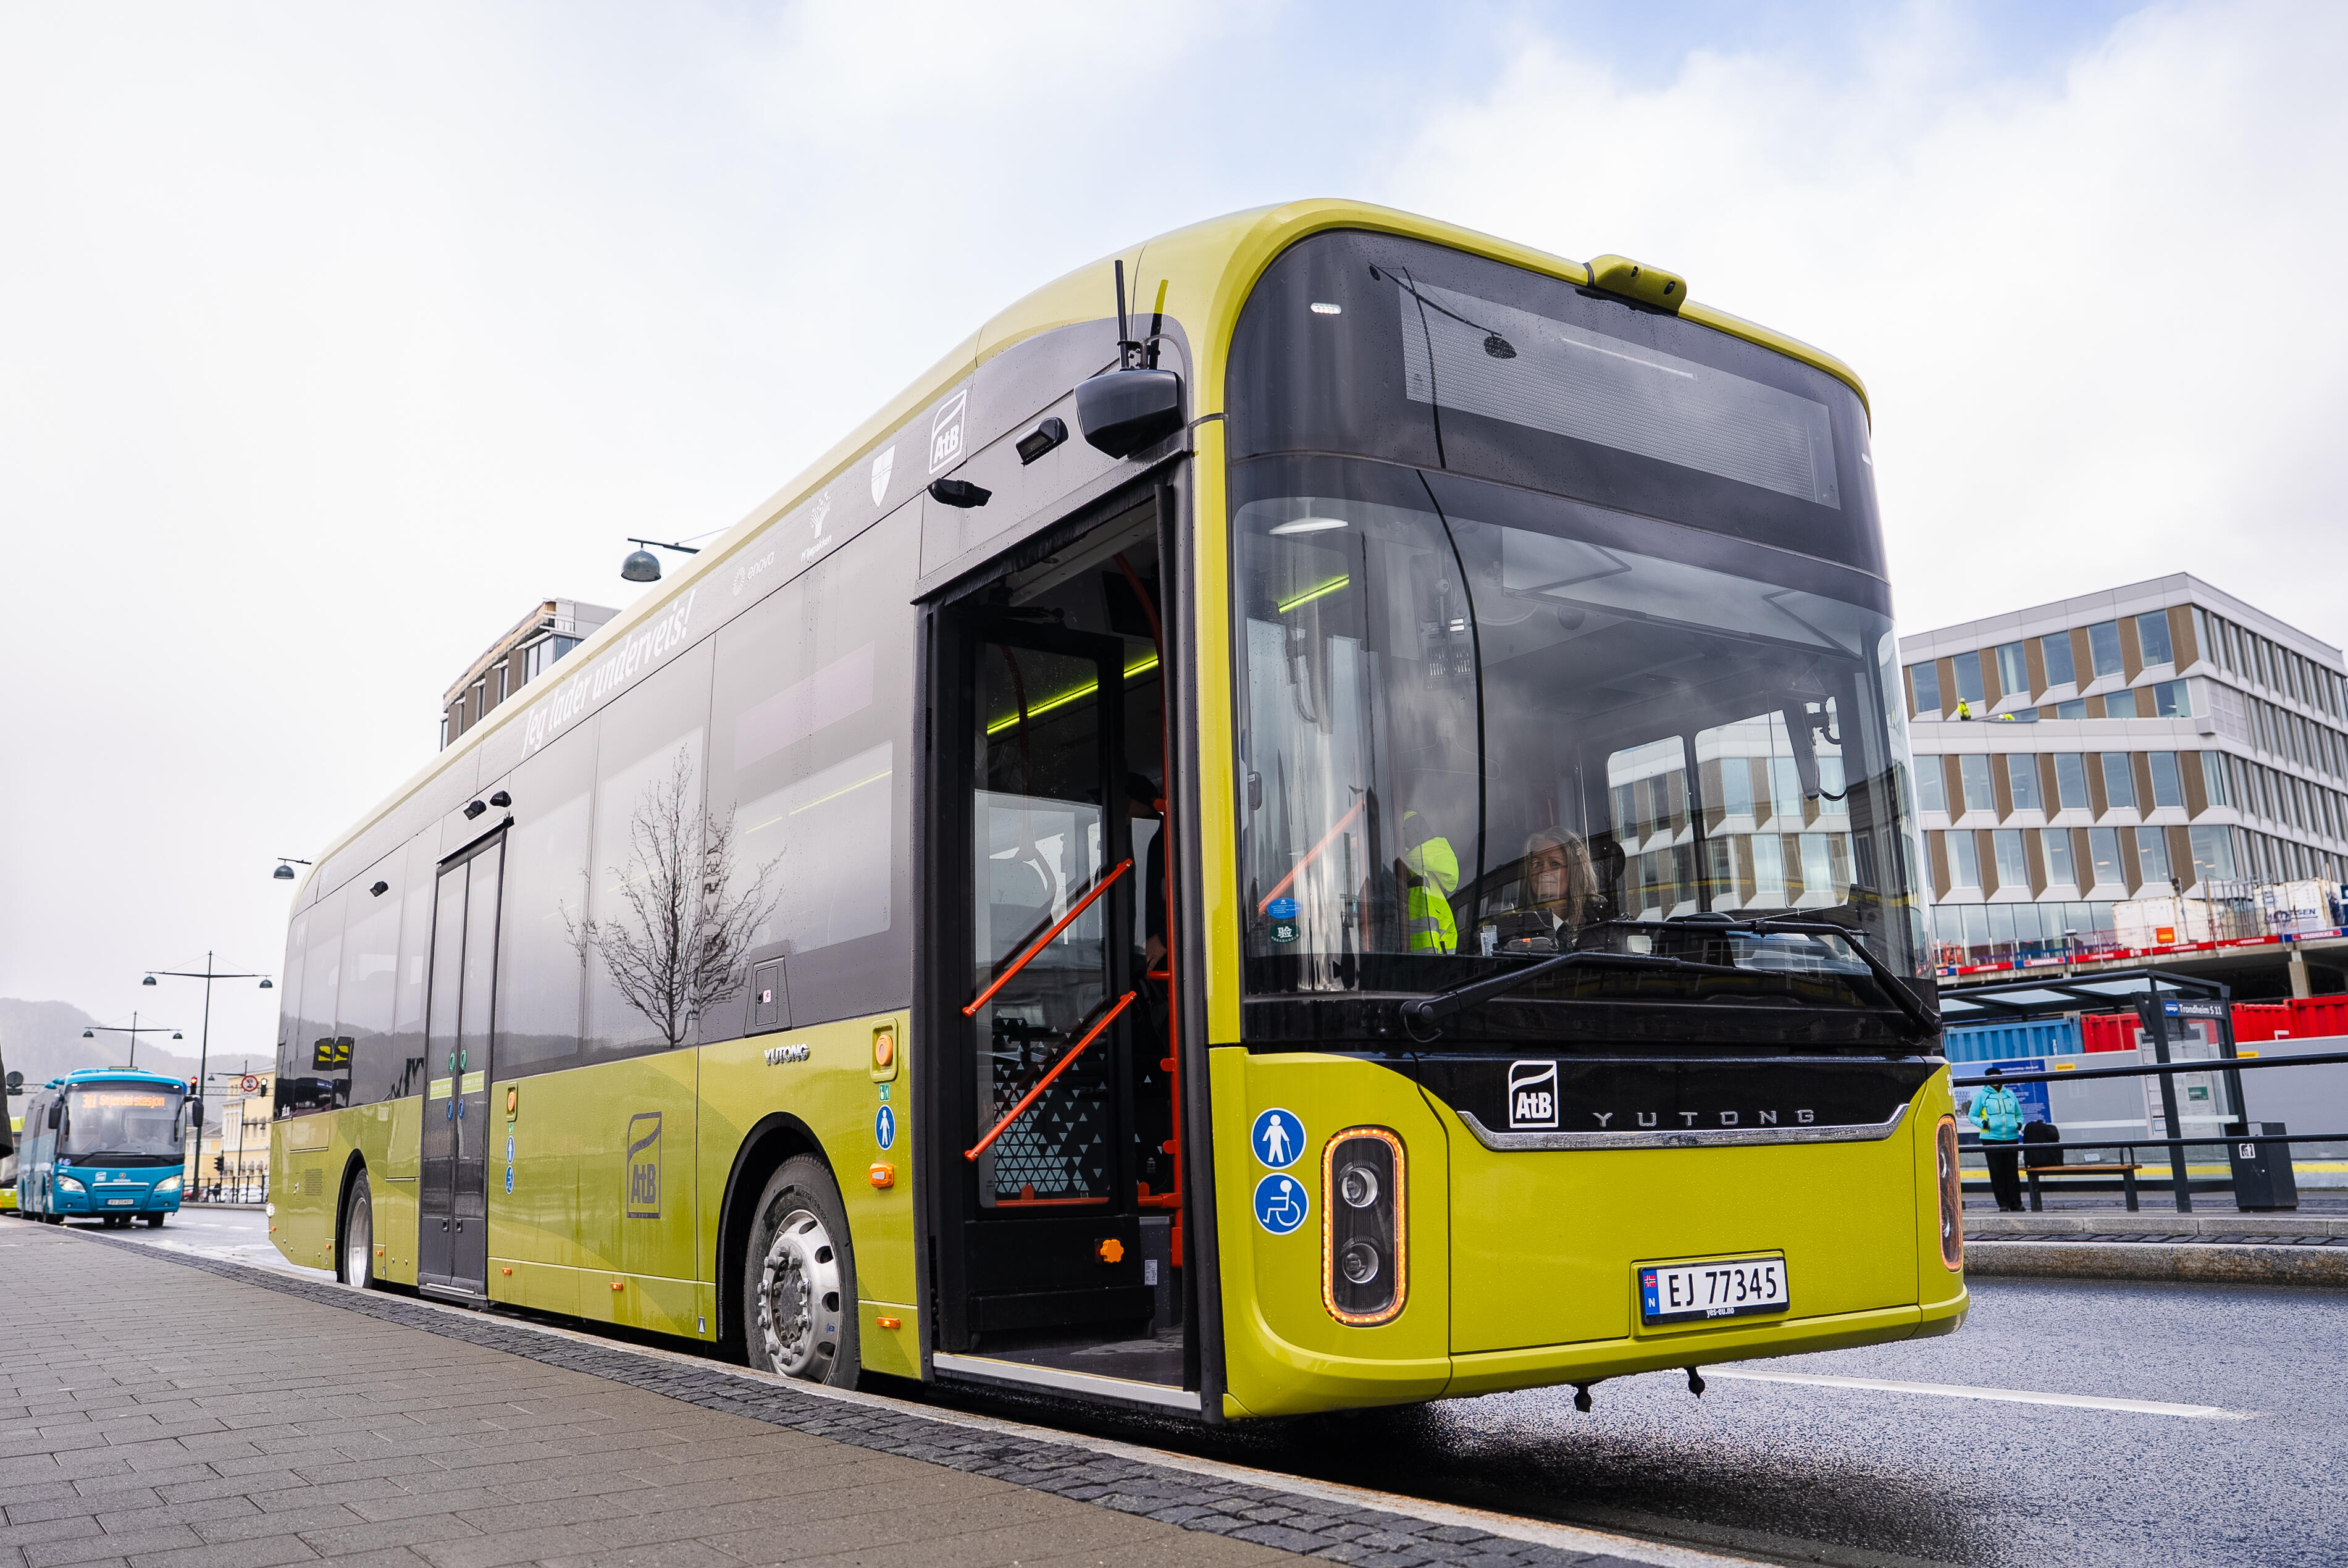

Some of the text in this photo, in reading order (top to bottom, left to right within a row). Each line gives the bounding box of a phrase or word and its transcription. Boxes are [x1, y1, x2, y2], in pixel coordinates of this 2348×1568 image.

[933, 424, 960, 465] AtB
[747, 551, 774, 579] enova
[521, 588, 697, 761] Jeg lader underveis!
[1277, 926, 1293, 938] 验
[2179, 1004, 2222, 1015] Trondheim S 11
[764, 1044, 810, 1066] YUTONG
[82, 1094, 98, 1108] 311
[134, 1095, 166, 1109] stasjon
[1515, 1092, 1553, 1119] AtB
[1592, 1109, 1814, 1128] YUTONG
[631, 1163, 656, 1204] AtB
[1669, 1267, 1777, 1307] EJ 77345
[1648, 1298, 1656, 1308] N
[1706, 1307, 1734, 1319] yes-eu.no
